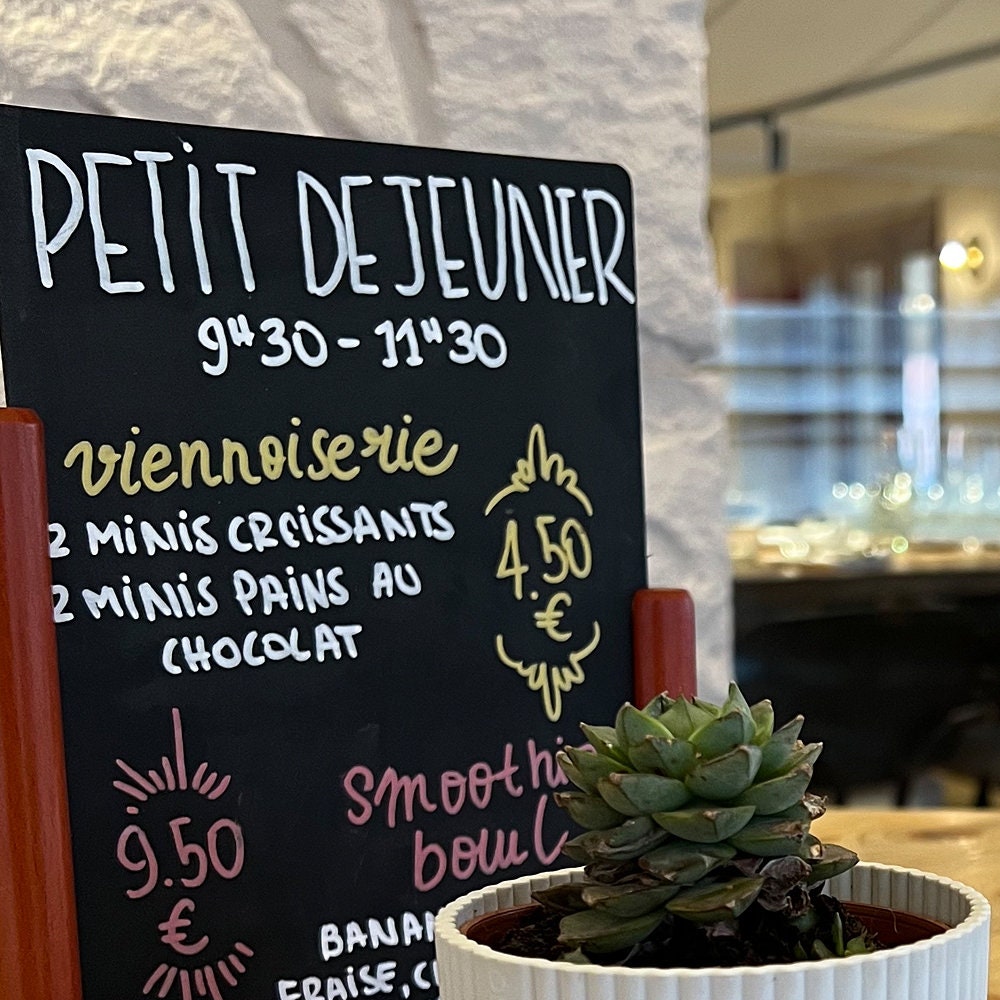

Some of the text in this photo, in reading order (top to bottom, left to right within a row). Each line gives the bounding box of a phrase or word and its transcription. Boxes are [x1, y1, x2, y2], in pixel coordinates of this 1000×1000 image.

[297, 170, 636, 306] DEJEUNER
[64, 414, 458, 496] viennoiserie
[48, 522, 71, 558] 2
[496, 515, 593, 600] 4.50
[51, 584, 75, 623] 2
[372, 562, 422, 598] AU
[534, 591, 572, 642] €
[162, 624, 362, 674] CHOCOLAT
[344, 736, 597, 828] smoothi
[116, 816, 245, 899] 9.50
[414, 794, 569, 892] bowl
[158, 898, 210, 955] €
